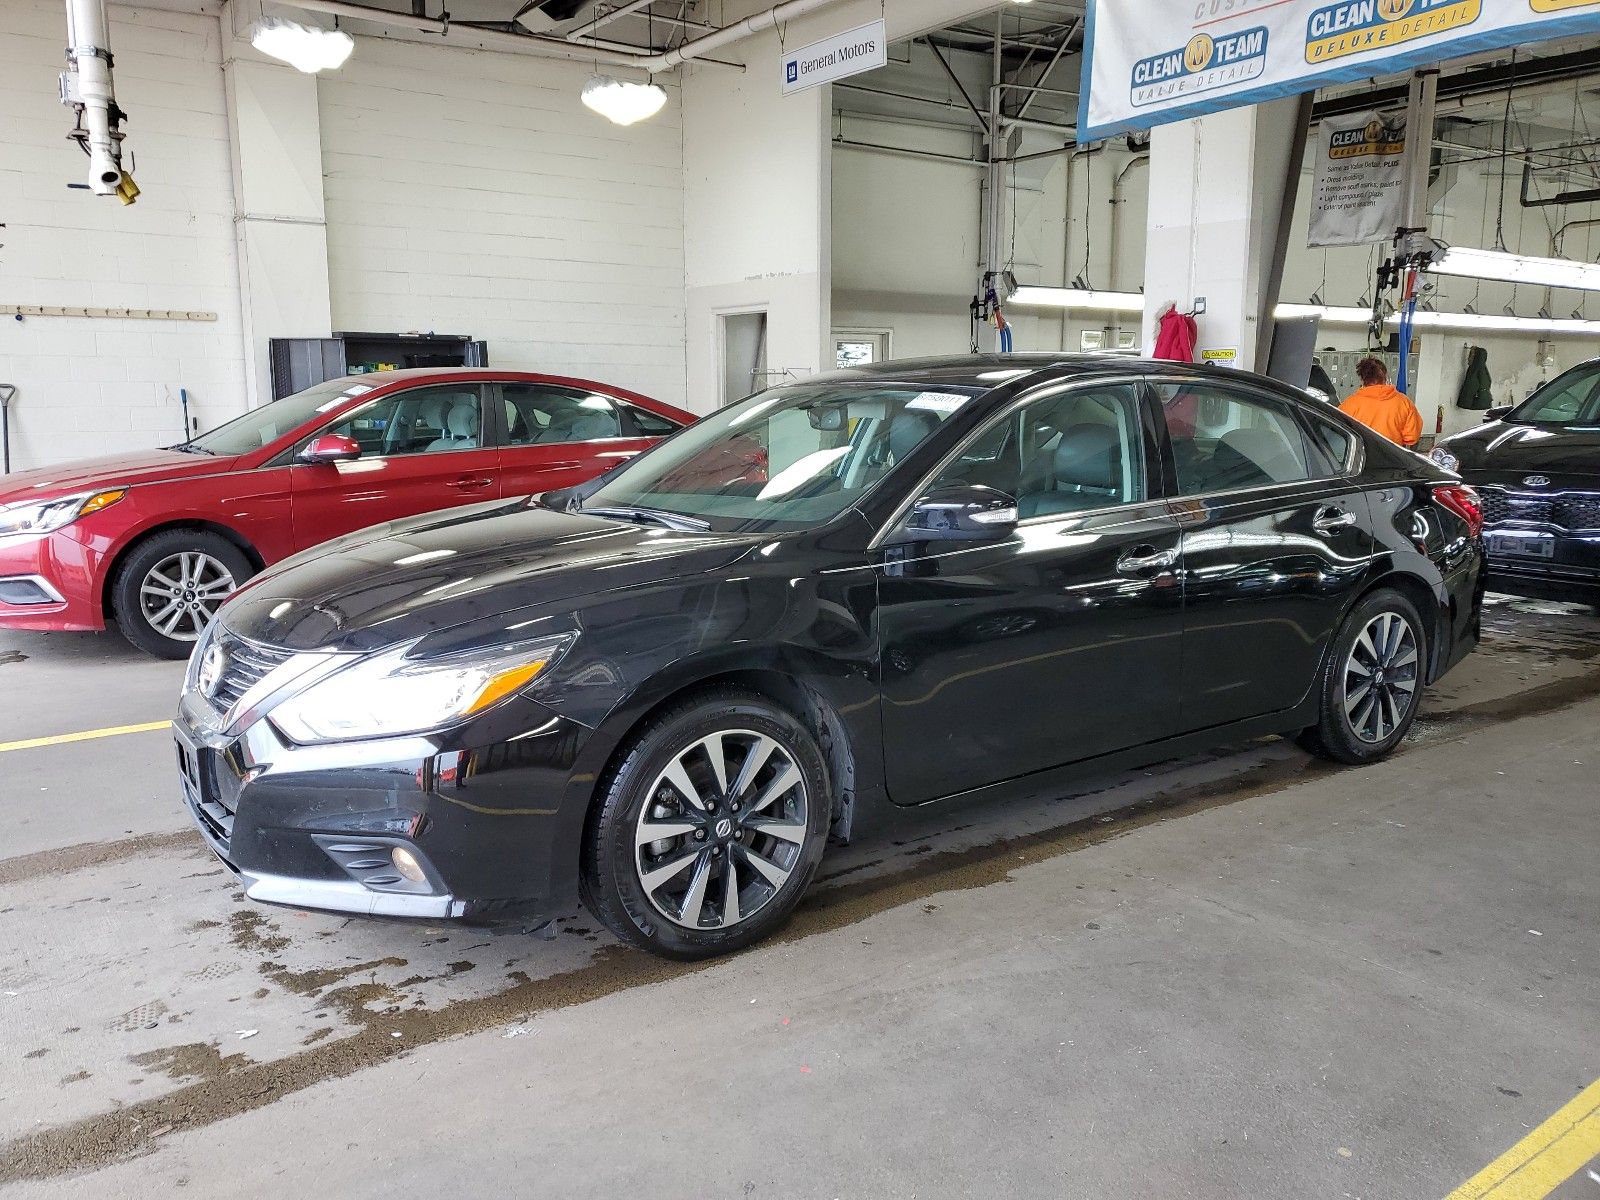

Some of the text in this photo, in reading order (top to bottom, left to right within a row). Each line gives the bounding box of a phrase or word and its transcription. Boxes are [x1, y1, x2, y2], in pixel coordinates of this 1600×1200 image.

[1311, 0, 1375, 37] CLEAN
[1314, 7, 1468, 57] DELUXE DETAIL
[800, 40, 875, 75] General Motors
[1135, 53, 1183, 84] CLEAN
[1216, 30, 1264, 62] TEAM
[1138, 63, 1254, 101] VALUE DETAIL
[1332, 130, 1364, 145] CLEAN
[1324, 194, 1338, 202] Light
